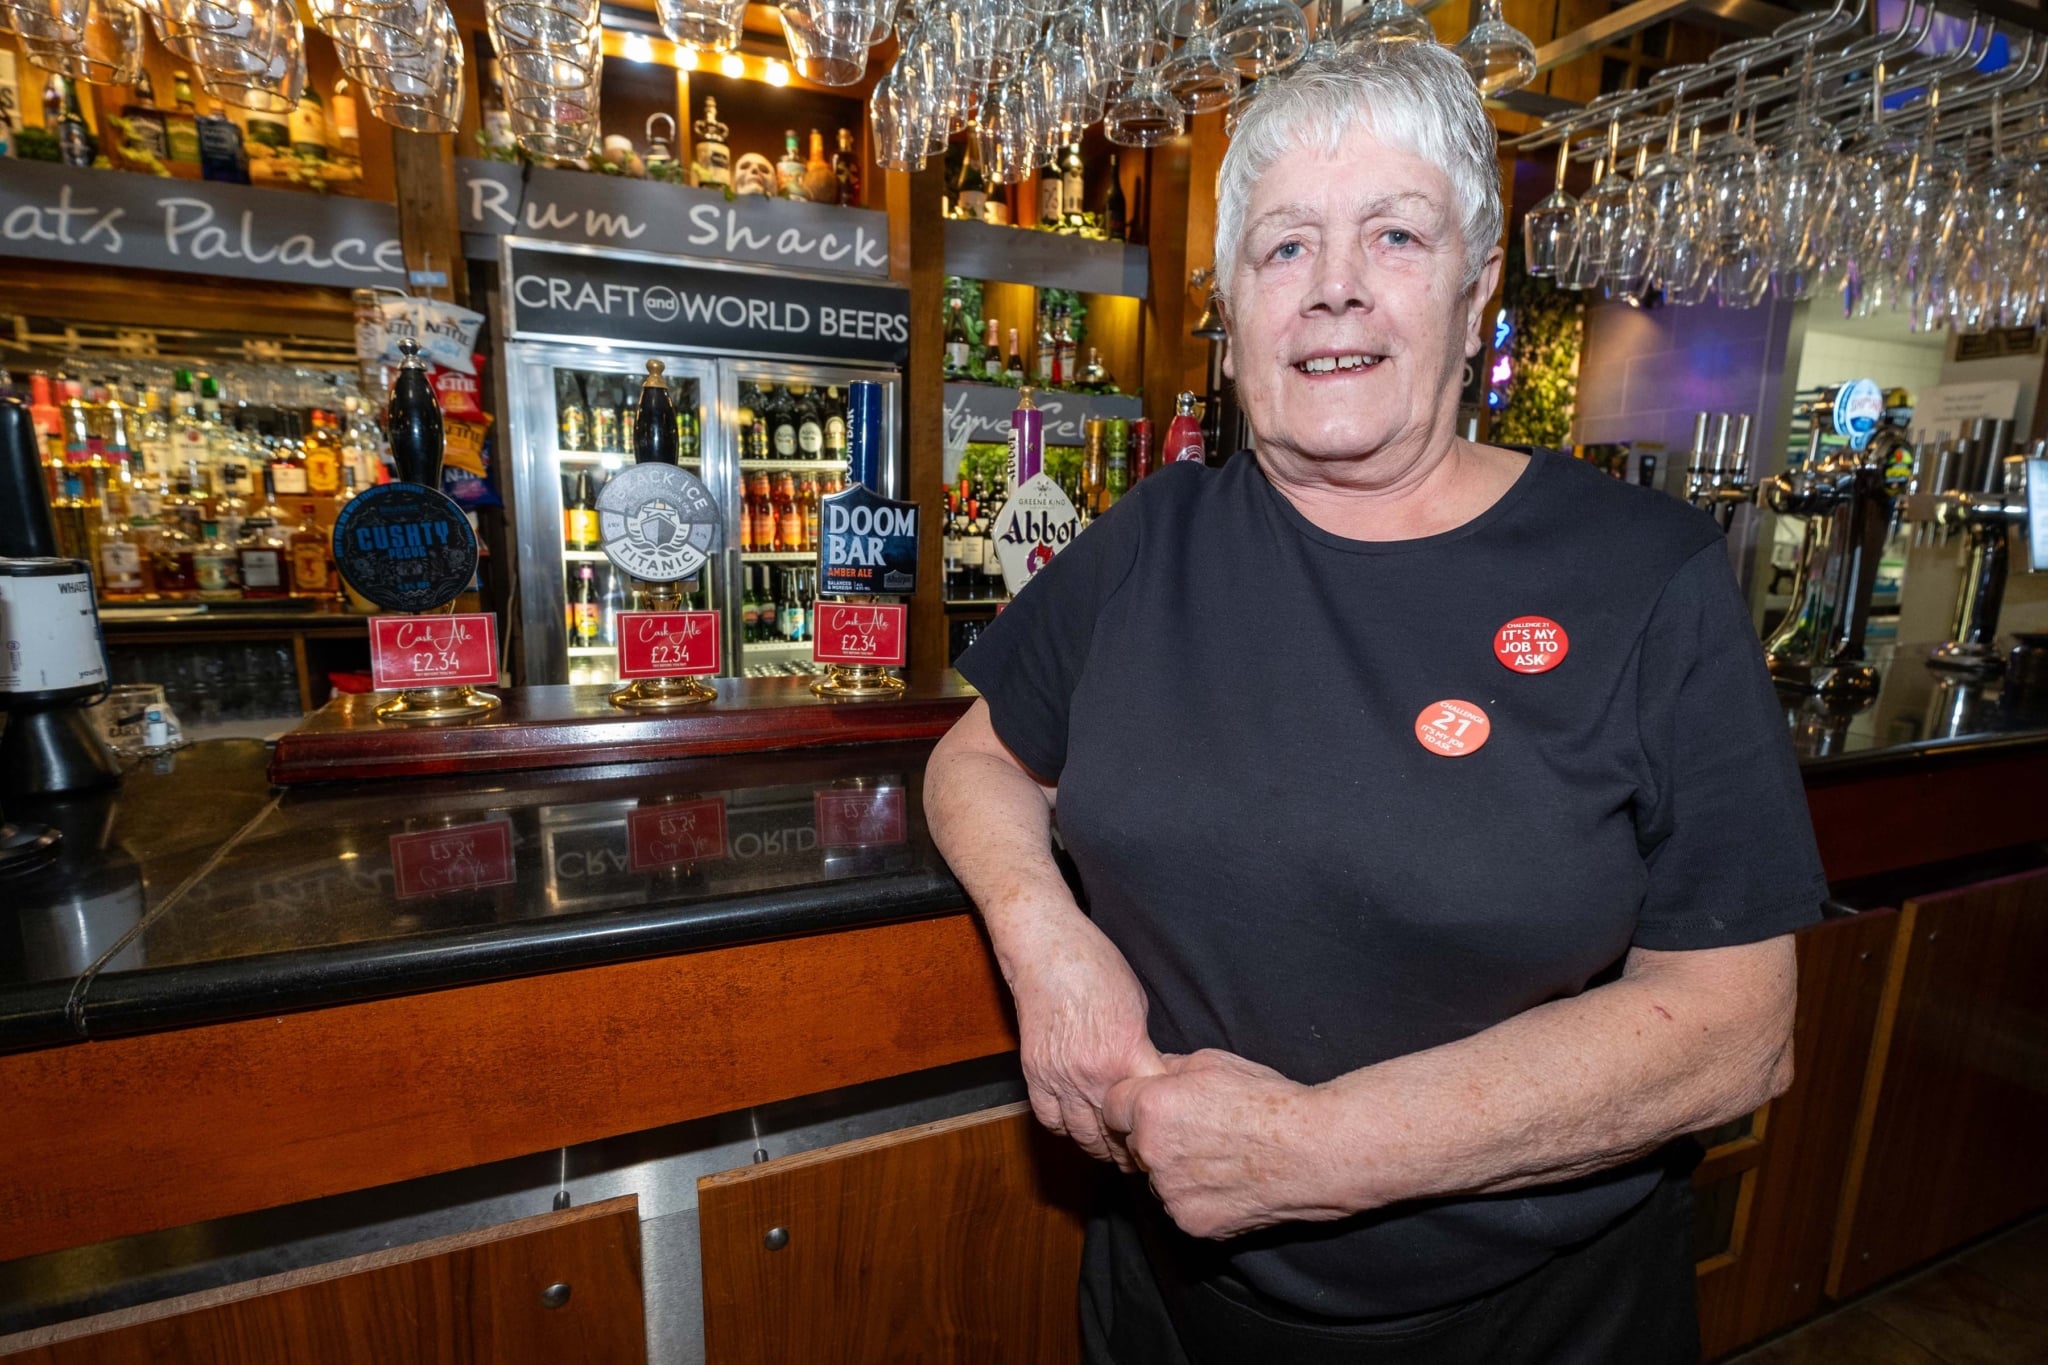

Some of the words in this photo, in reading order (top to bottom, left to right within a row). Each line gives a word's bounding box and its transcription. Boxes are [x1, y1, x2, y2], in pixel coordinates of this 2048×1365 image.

[158, 198, 406, 274] Palace
[467, 178, 646, 240] Rum
[688, 203, 888, 268] Shack
[514, 274, 640, 317] CRAFT
[646, 294, 676, 312] and
[680, 292, 810, 333] WORLD
[819, 307, 909, 343] BEERS
[681, 480, 709, 510] ICE
[828, 504, 915, 537] DOOM
[999, 510, 1079, 545] Abbot
[356, 521, 449, 551] CUSHTY
[827, 534, 887, 566] BAR
[619, 543, 694, 572] TITANIC
[828, 568, 856, 578] AMBER
[858, 568, 872, 578] ALE
[396, 623, 433, 649] Cask
[433, 616, 473, 652] Ale
[638, 618, 670, 643] Cask
[669, 613, 702, 645] Ale
[832, 608, 859, 630] Cask
[858, 605, 889, 635] Ale
[1502, 629, 1530, 640] IT'S
[1534, 629, 1557, 640] MY
[650, 645, 690, 664] £2.34
[841, 634, 876, 652] £2.34
[1500, 642, 1532, 654] JOB
[1536, 641, 1558, 652] TO
[413, 652, 460, 672] £2.34
[1514, 654, 1545, 666] ASK
[1432, 710, 1472, 737] 21
[1440, 701, 1485, 724] CHALLENGE
[1424, 734, 1436, 744] TO
[1434, 740, 1451, 752] ASK
[1434, 730, 1450, 740] MY
[1448, 738, 1464, 748] JOB
